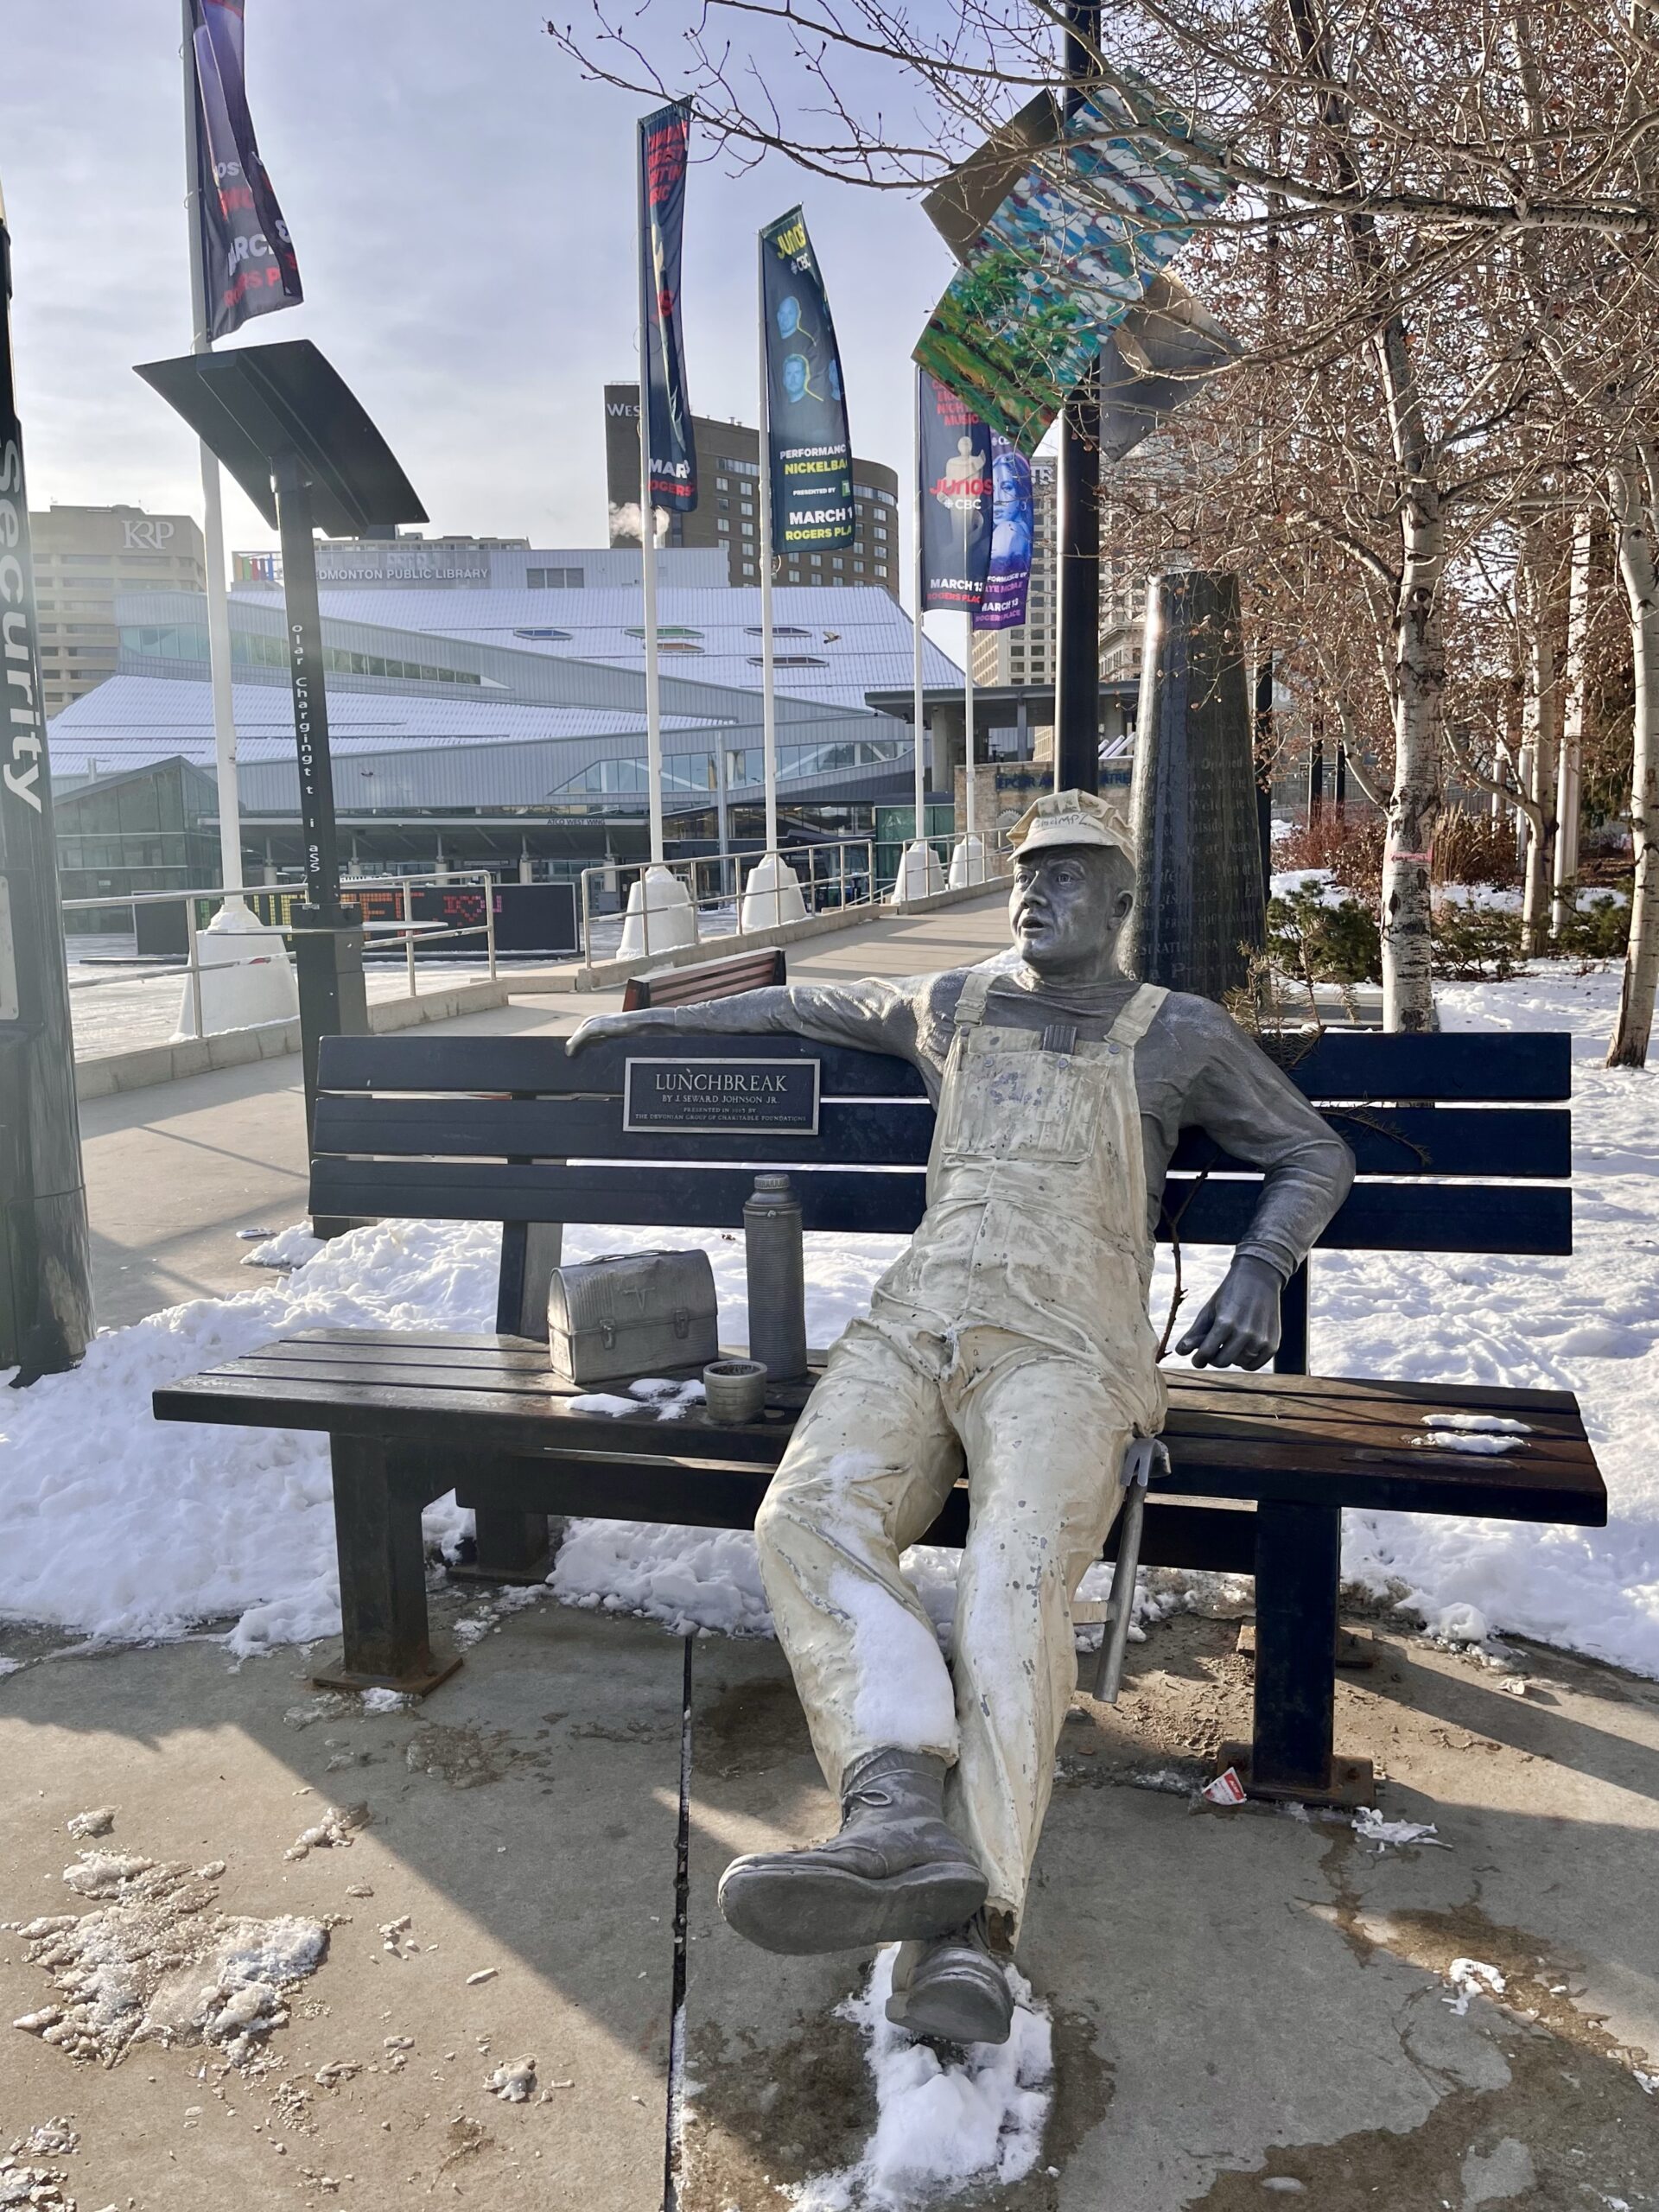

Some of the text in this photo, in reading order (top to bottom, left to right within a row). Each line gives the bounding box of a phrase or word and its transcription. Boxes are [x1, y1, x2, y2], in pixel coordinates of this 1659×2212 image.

[944, 413, 979, 427] MUSIC
[785, 459, 848, 474] NICKELBA
[955, 499, 982, 510] CBC
[789, 507, 846, 525] MARCH
[121, 520, 175, 550] KRP
[785, 529, 833, 541] ROGERS
[387, 567, 432, 580] PUBLIC
[435, 567, 488, 579] LIBRARY
[931, 578, 971, 592] MARCH
[926, 592, 961, 602] ROGERS
[0, 439, 43, 814] Security
[655, 1073, 788, 1092] LUNCHBREAK
[662, 1094, 673, 1103] BY
[683, 1094, 719, 1103] SEWARD
[721, 1095, 763, 1104] JOHNSON
